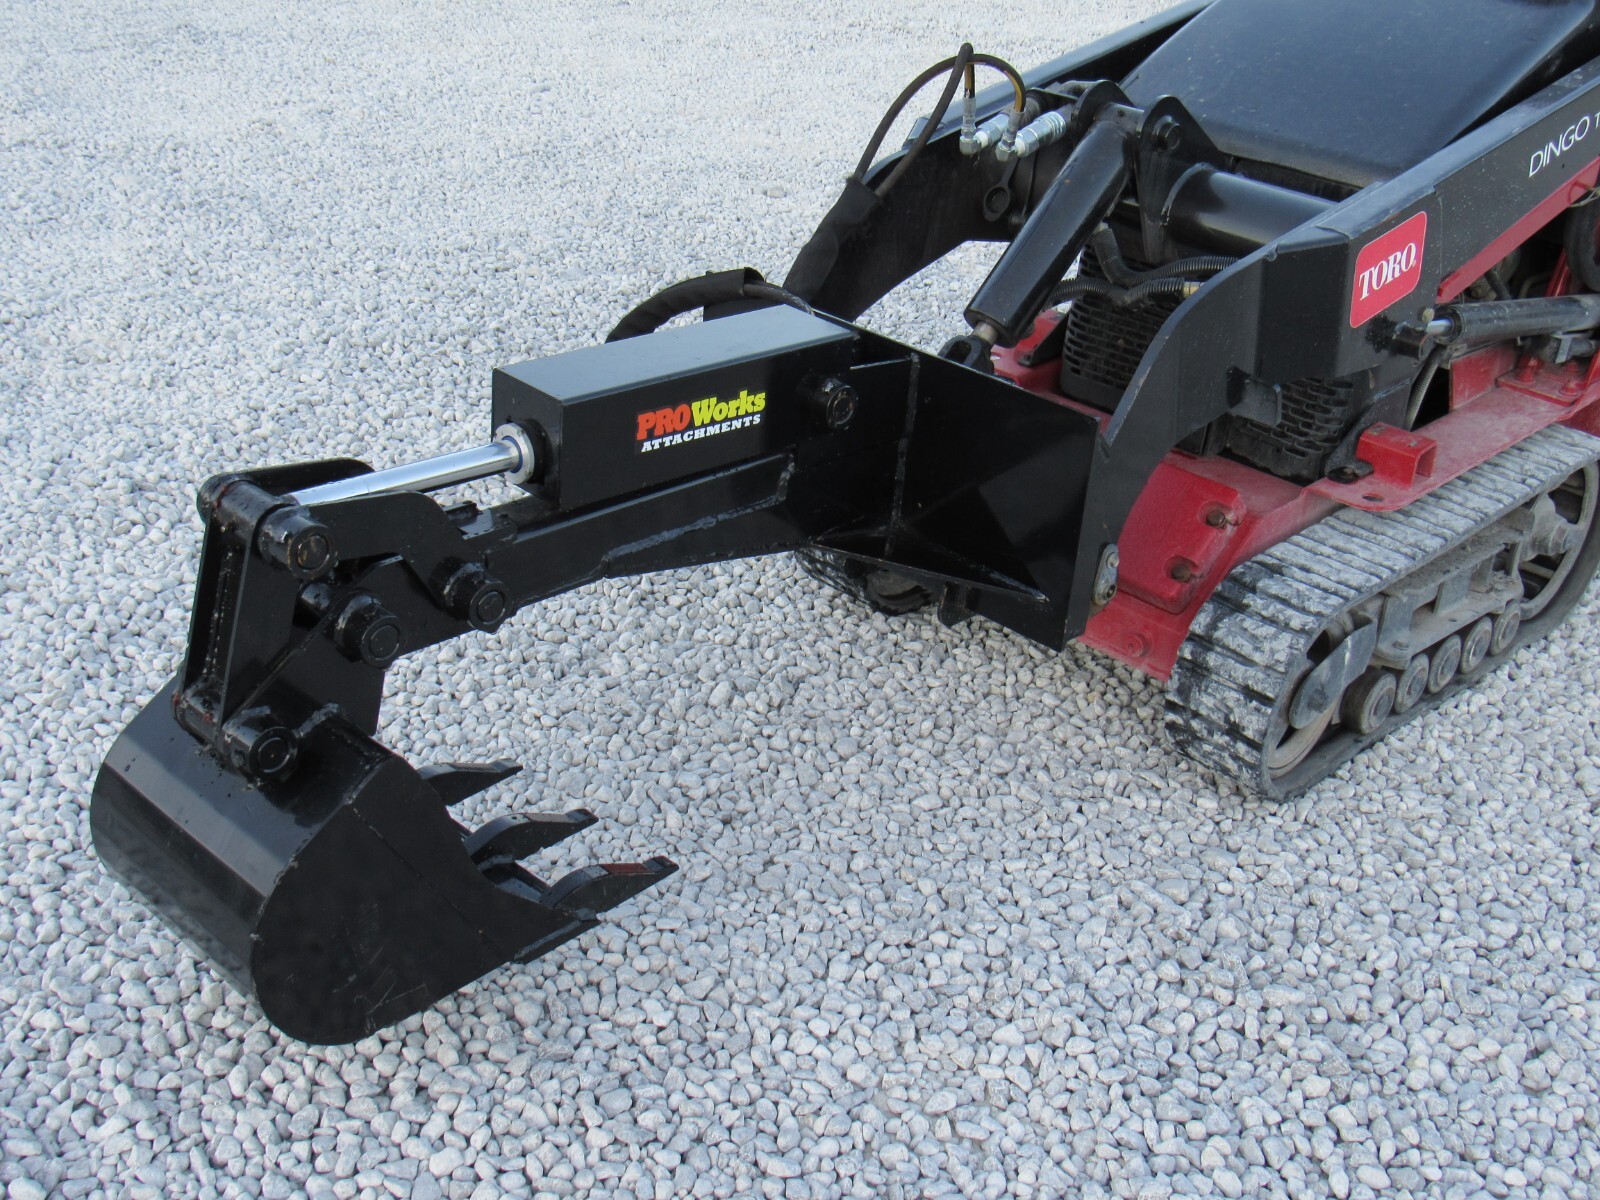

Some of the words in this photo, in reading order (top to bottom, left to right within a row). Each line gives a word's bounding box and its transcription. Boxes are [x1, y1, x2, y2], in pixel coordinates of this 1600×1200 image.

[1528, 115, 1590, 178] DINGO
[1358, 242, 1417, 301] TORO
[641, 413, 761, 453] ATTACHMENTS
